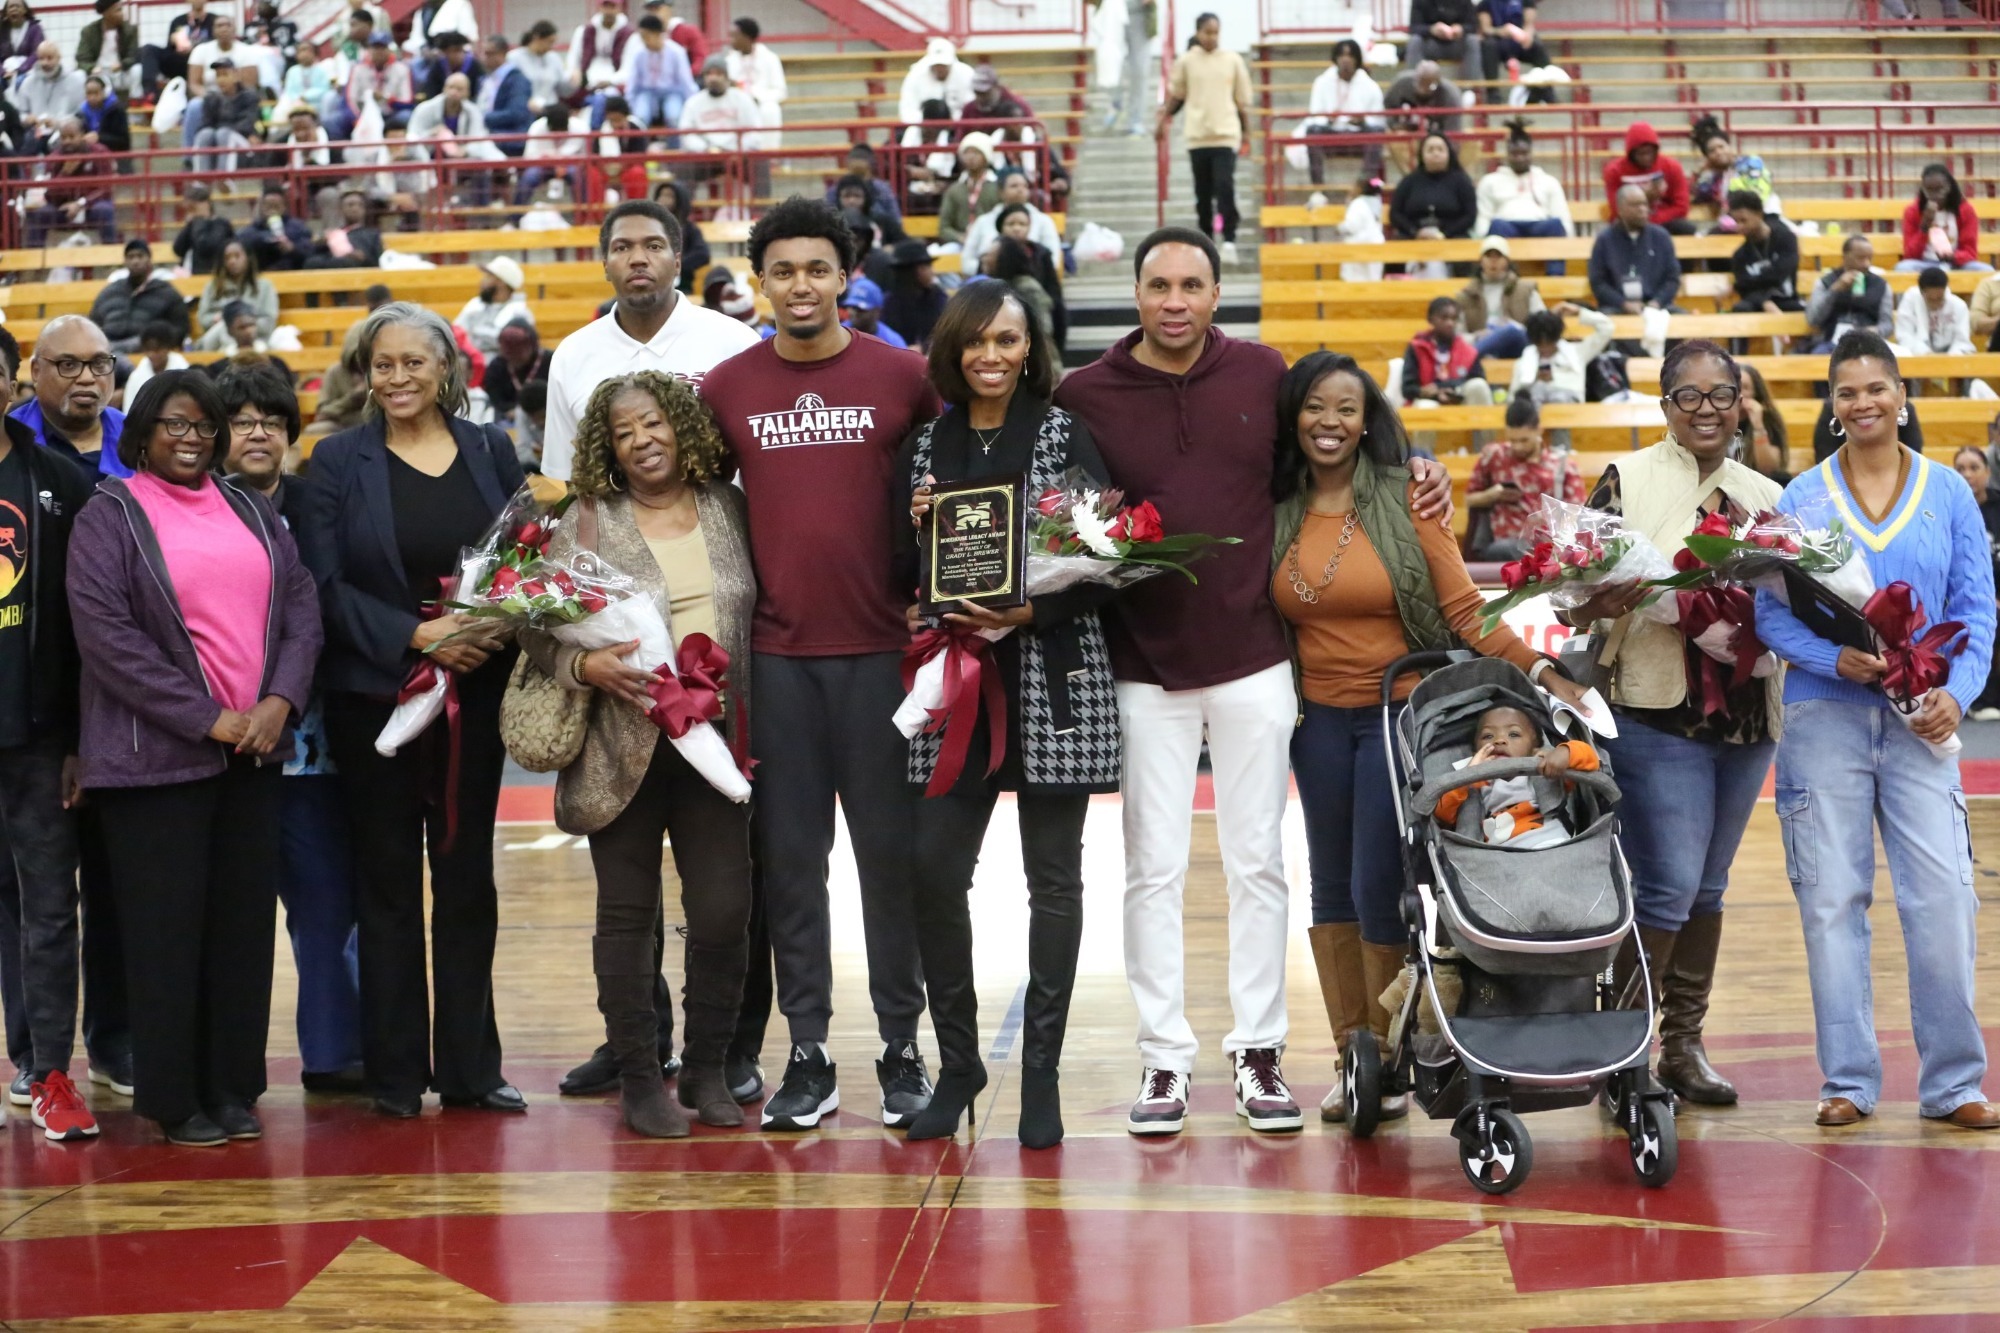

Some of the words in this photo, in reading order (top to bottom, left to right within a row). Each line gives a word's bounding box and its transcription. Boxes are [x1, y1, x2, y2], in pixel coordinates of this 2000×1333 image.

[749, 410, 875, 437] TALLADEGA
[761, 429, 864, 446] BASKETBALL
[940, 535, 968, 544] MOREHOUSE
[969, 532, 988, 540] LEGACY
[945, 552, 967, 560] GRADY
[973, 548, 1000, 557] BREWER
